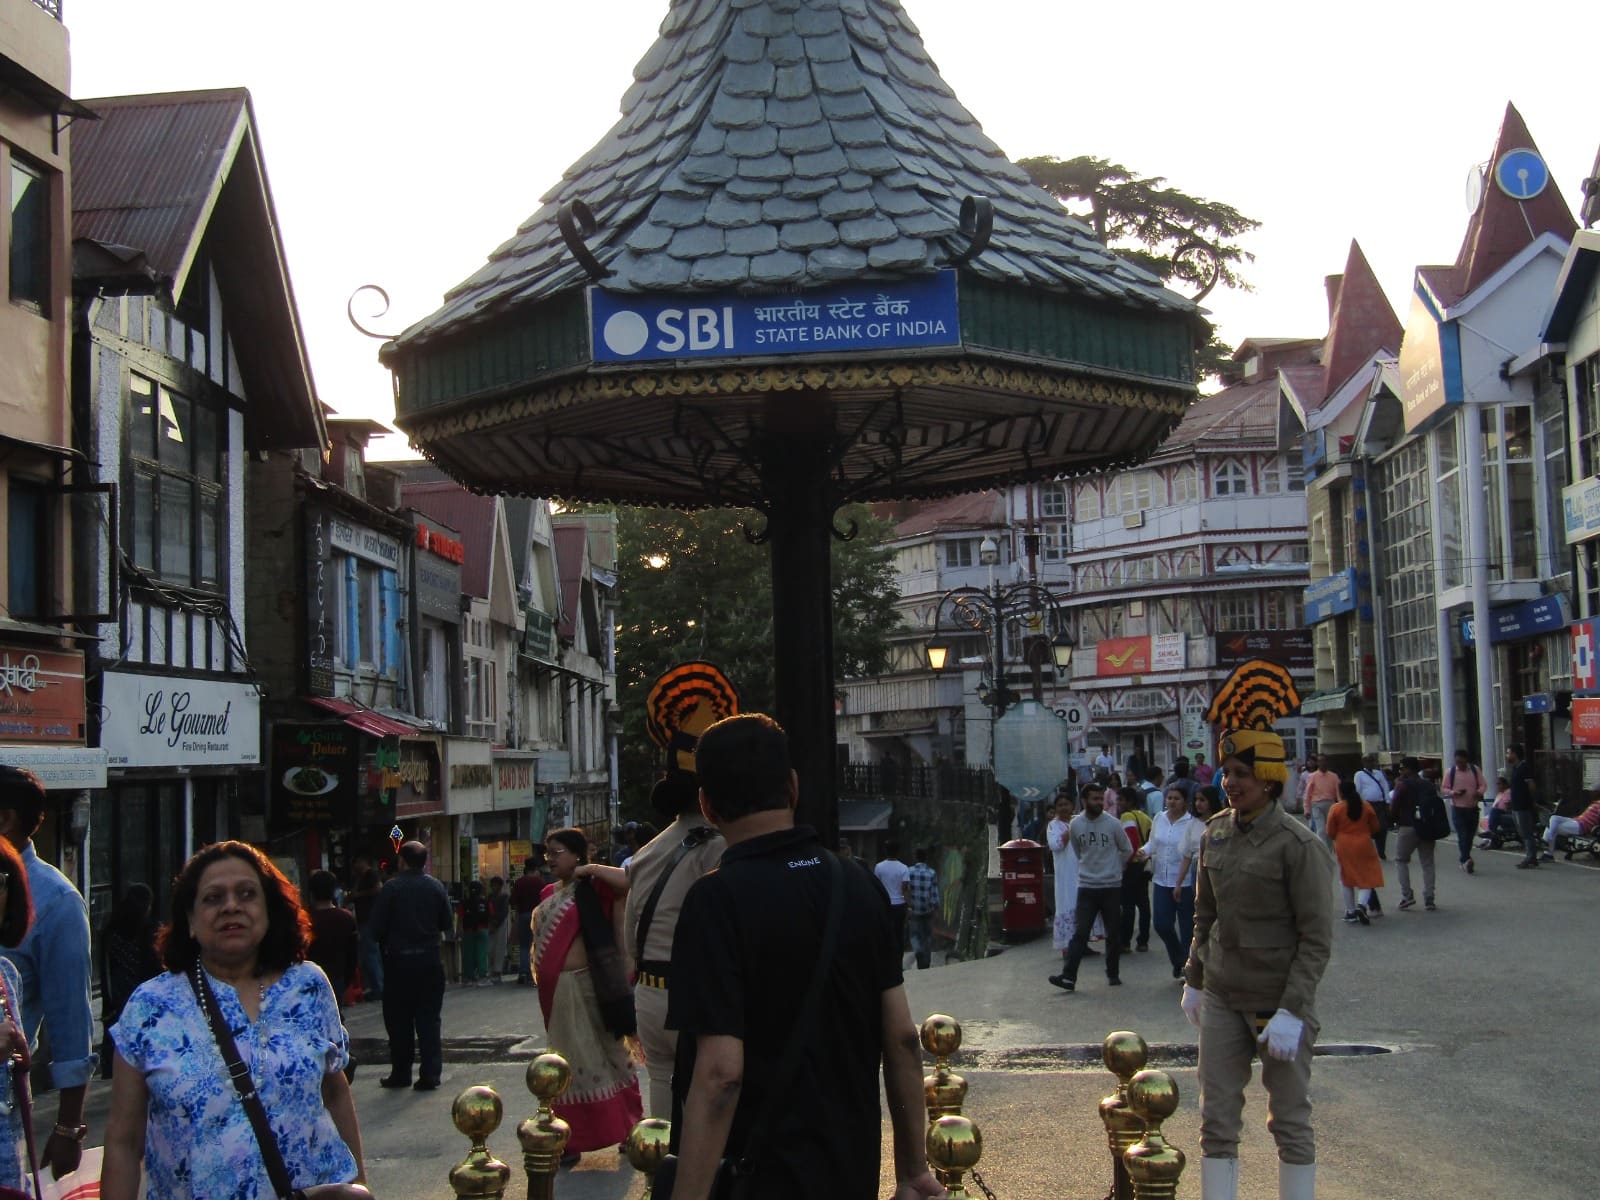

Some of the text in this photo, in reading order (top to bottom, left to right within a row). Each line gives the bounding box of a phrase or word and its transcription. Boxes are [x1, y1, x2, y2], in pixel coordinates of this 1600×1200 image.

[754, 294, 911, 323] भारतीय स्टेट बैंक
[656, 306, 735, 353] SBI
[755, 320, 947, 344] STATE BANK OF INDIA
[140, 690, 231, 748] Le Gourmet
[498, 767, 516, 791] BAND
[1079, 831, 1109, 847] GAP
